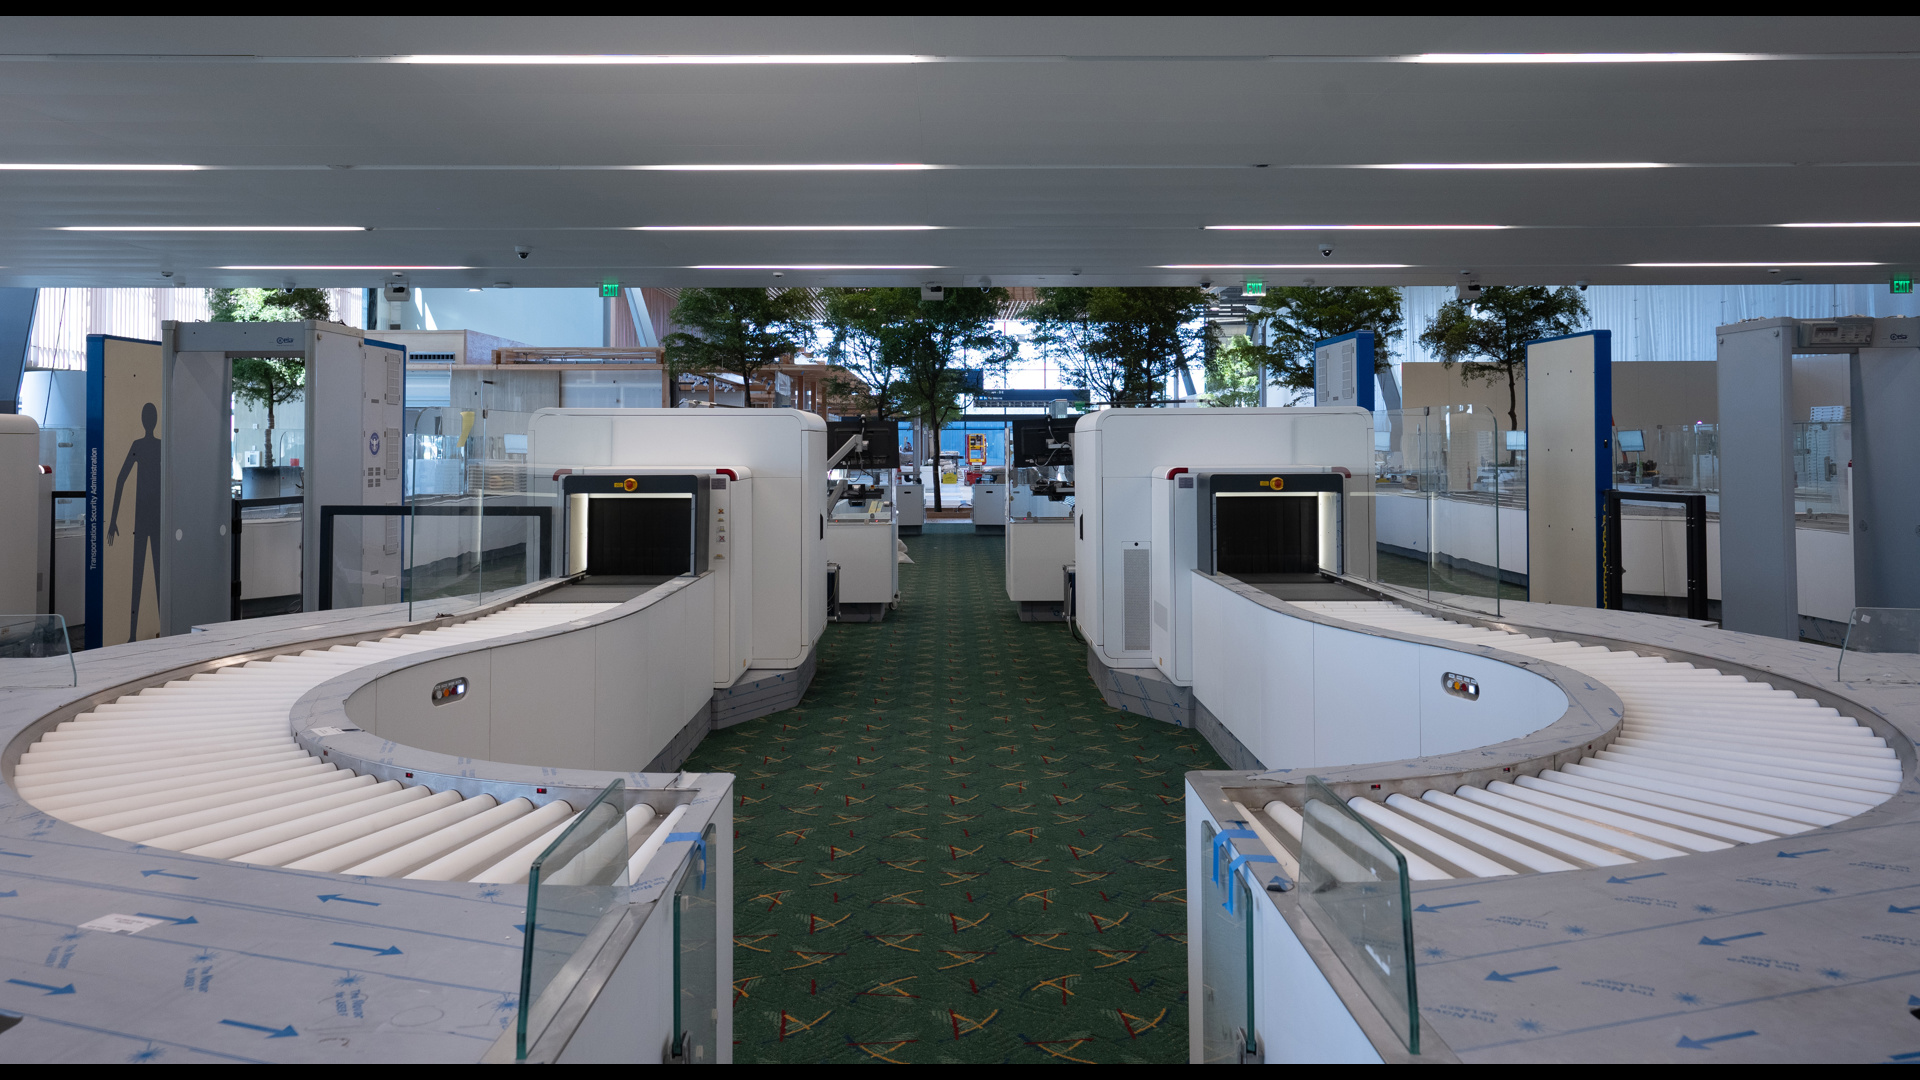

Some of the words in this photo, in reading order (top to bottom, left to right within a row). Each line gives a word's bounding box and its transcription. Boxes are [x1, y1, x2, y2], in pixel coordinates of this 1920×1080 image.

[603, 284, 619, 296] EXIT
[1247, 283, 1263, 295] EXIT
[1894, 280, 1910, 293] EXIT
[90, 447, 98, 495] Administration
[90, 495, 98, 522] Security
